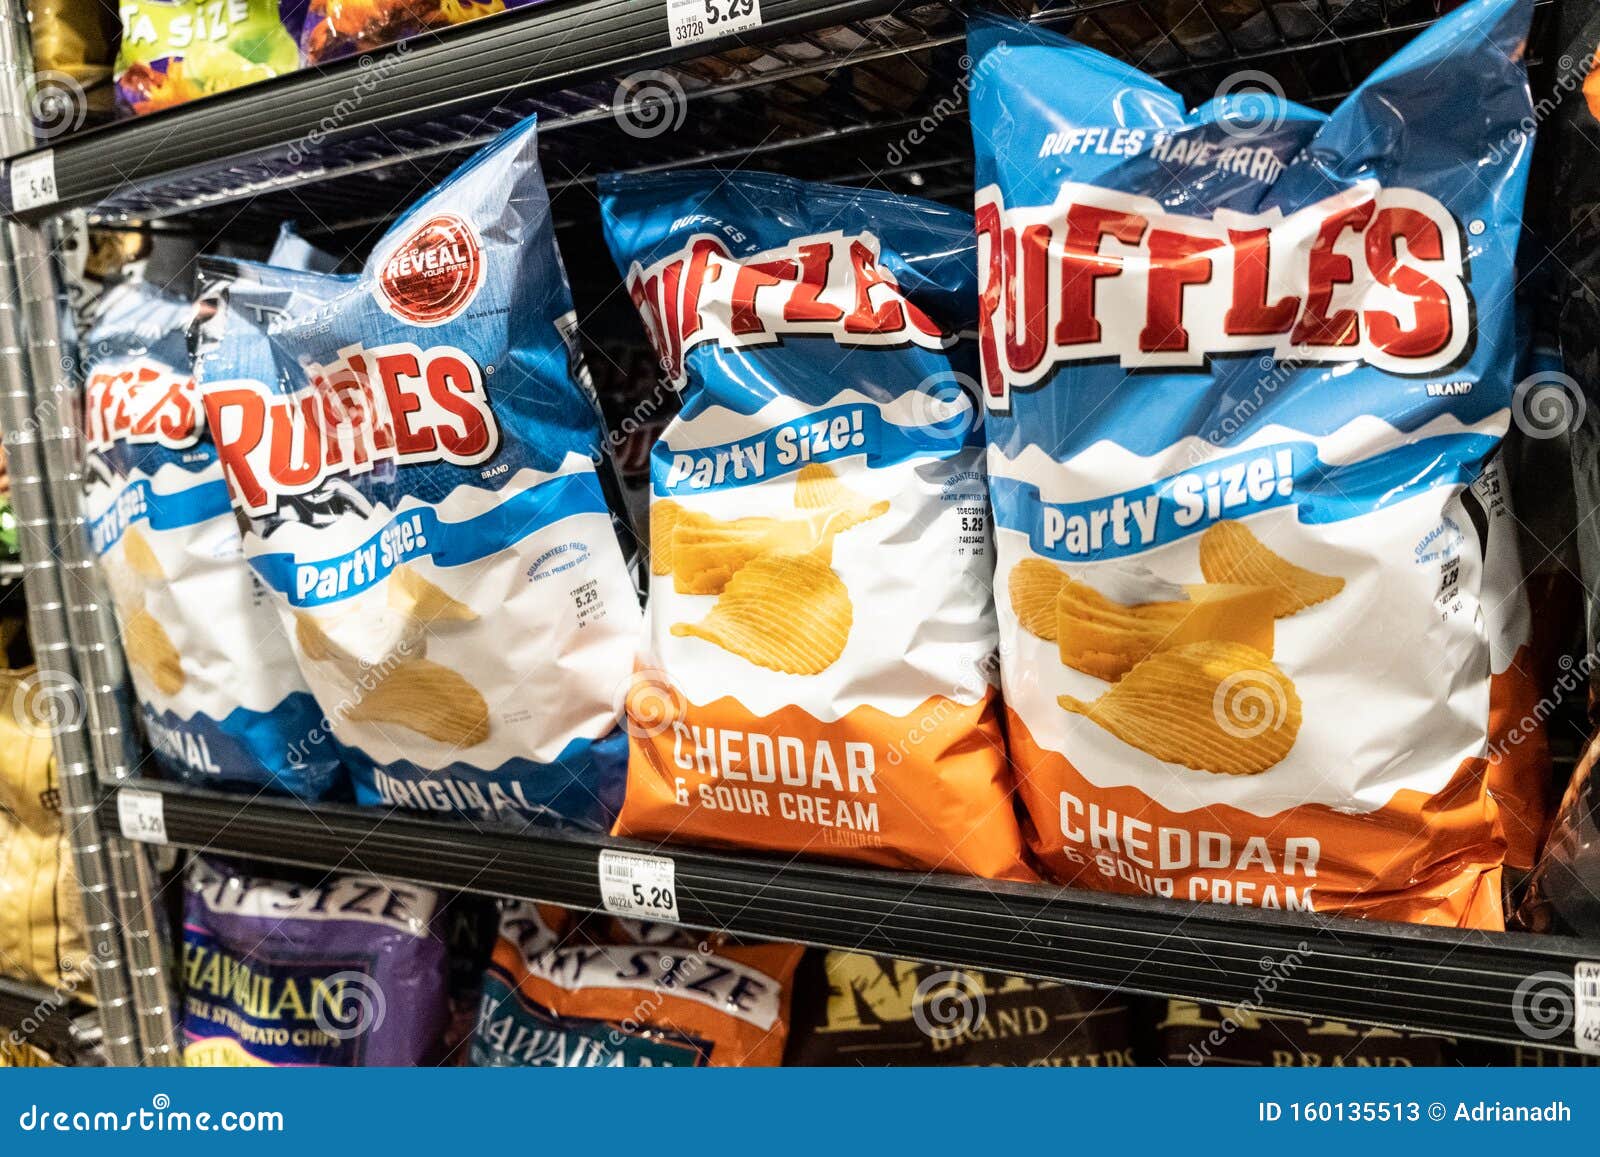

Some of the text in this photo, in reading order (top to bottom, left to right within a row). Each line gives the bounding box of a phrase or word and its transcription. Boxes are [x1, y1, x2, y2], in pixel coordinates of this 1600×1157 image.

[676, 20, 704, 41] 33728
[1039, 128, 1146, 158] RUFFLES
[669, 214, 747, 244] RUFFLES
[387, 243, 468, 280] REVEAL
[422, 267, 445, 278] YOUR
[976, 199, 1451, 397] RUFFLES
[1426, 381, 1473, 396] BRAND
[666, 441, 766, 489] Party
[775, 409, 865, 466] Size!
[481, 463, 510, 480] BRAND
[1043, 448, 1294, 555] Party Size!
[962, 517, 983, 532] 5.29
[296, 544, 377, 600] Party
[527, 544, 569, 577] GUARANTEED
[575, 589, 598, 609] 5.29
[673, 721, 877, 794] CHEDDAR
[699, 783, 770, 817] SOUR
[779, 791, 880, 833] CREAM
[1060, 791, 1321, 877] CHEDDAR
[1096, 855, 1174, 899] SOUR
[632, 883, 674, 910] 5.29
[616, 952, 769, 1011] SIZE
[930, 1005, 1048, 1051] BRAND
